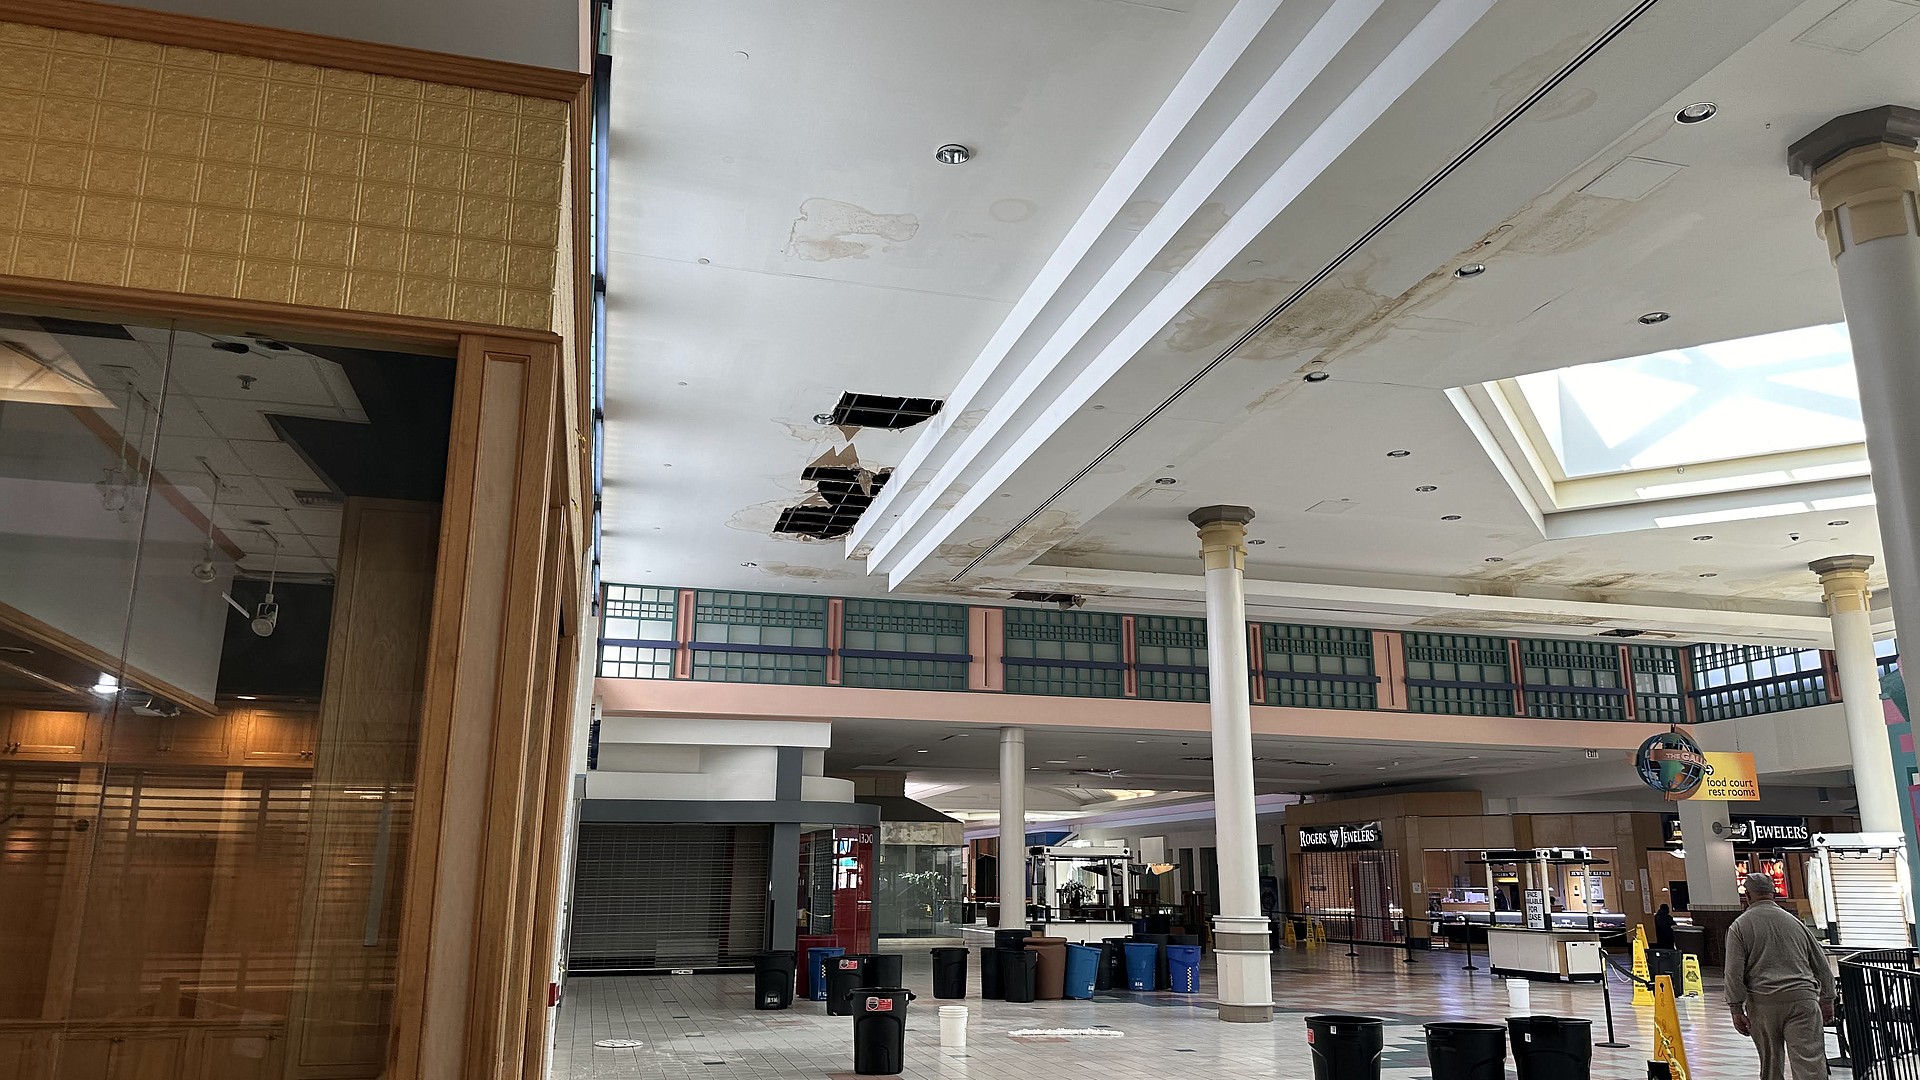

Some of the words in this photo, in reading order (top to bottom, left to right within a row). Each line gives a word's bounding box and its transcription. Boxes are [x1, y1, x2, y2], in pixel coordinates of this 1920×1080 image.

[1706, 777, 1727, 787] food
[1729, 779, 1754, 788] court
[1708, 788, 1726, 796] rest
[1728, 789, 1756, 797] rooms
[1299, 830, 1327, 847] ROGERS
[1340, 826, 1375, 848] JEWELERS
[1749, 819, 1809, 844] JEWELERS
